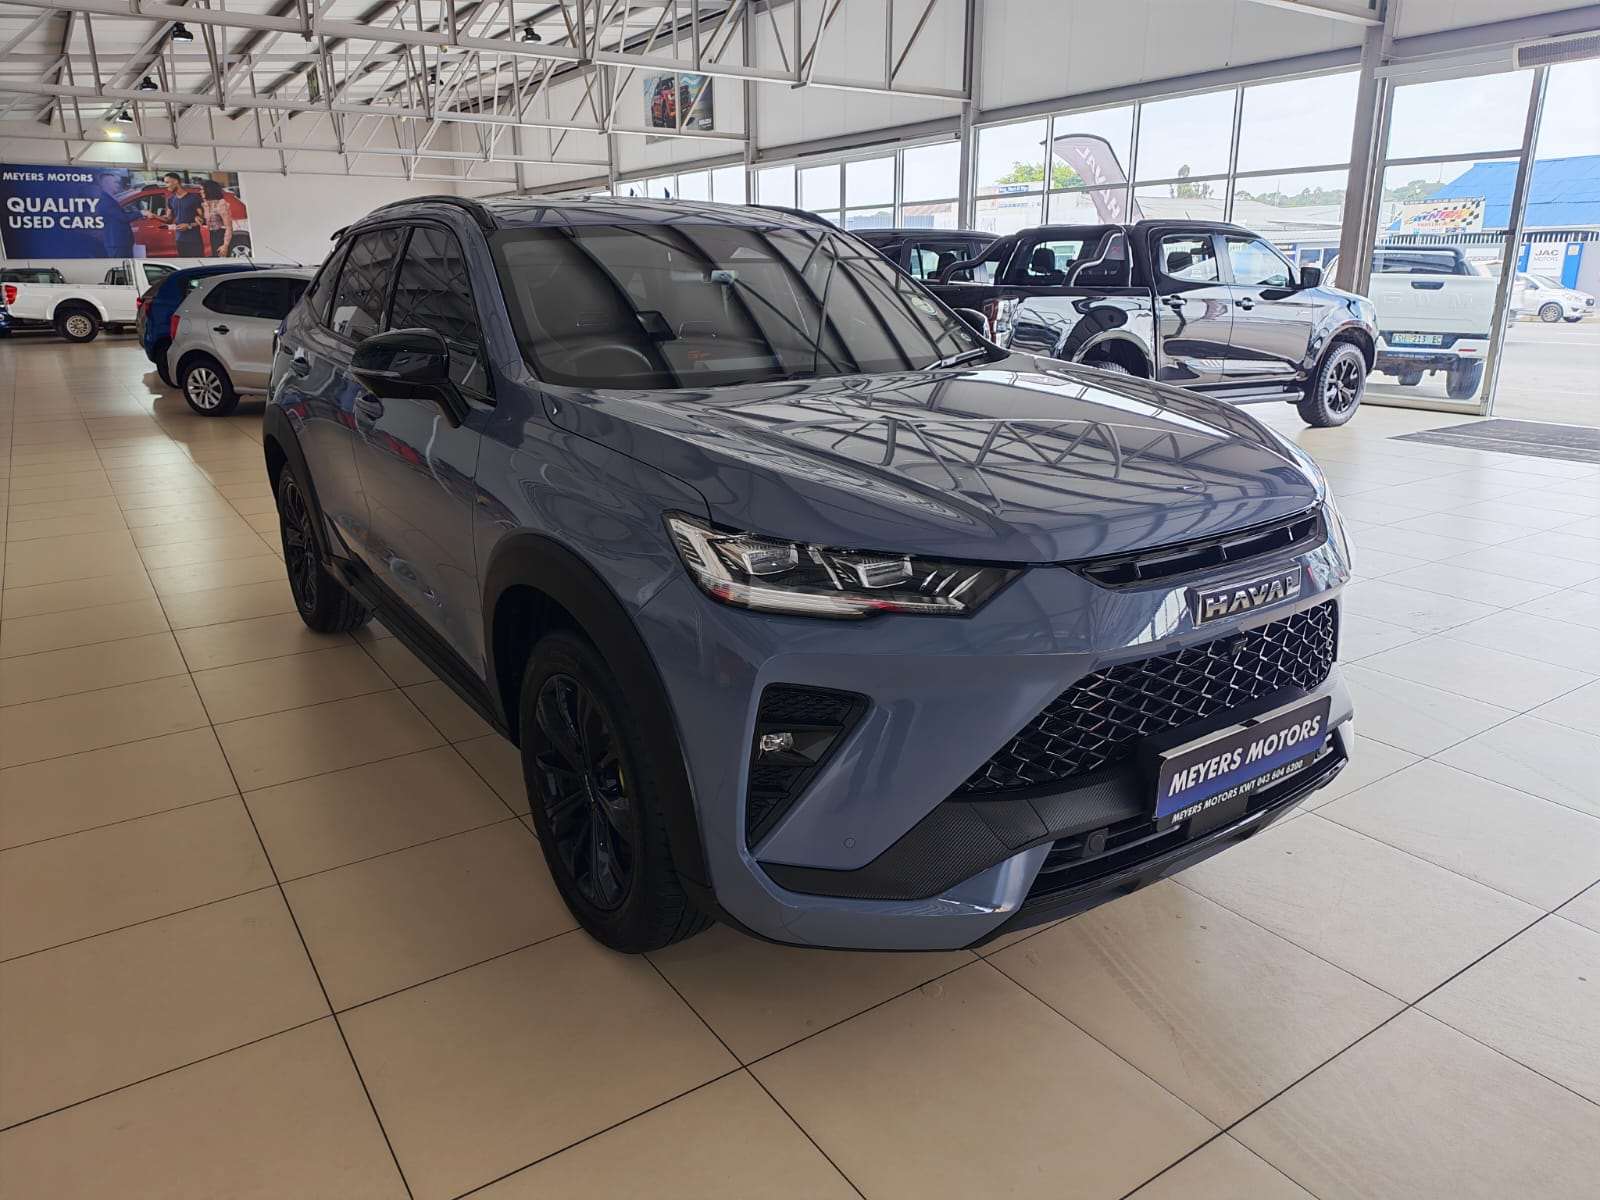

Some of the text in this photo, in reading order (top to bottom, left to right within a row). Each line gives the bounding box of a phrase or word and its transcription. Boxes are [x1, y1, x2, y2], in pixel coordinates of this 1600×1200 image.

[2, 172, 94, 182] MEYERS MOTORS
[7, 197, 100, 213] QUALITY
[9, 215, 105, 229] USED CARS
[1205, 576, 1300, 618] HAVAL
[1168, 715, 1321, 797] MEYERS MOTORS
[1171, 802, 1202, 824] MEYERS
[1203, 788, 1238, 812] MOTORS
[1238, 781, 1256, 795] KWT
